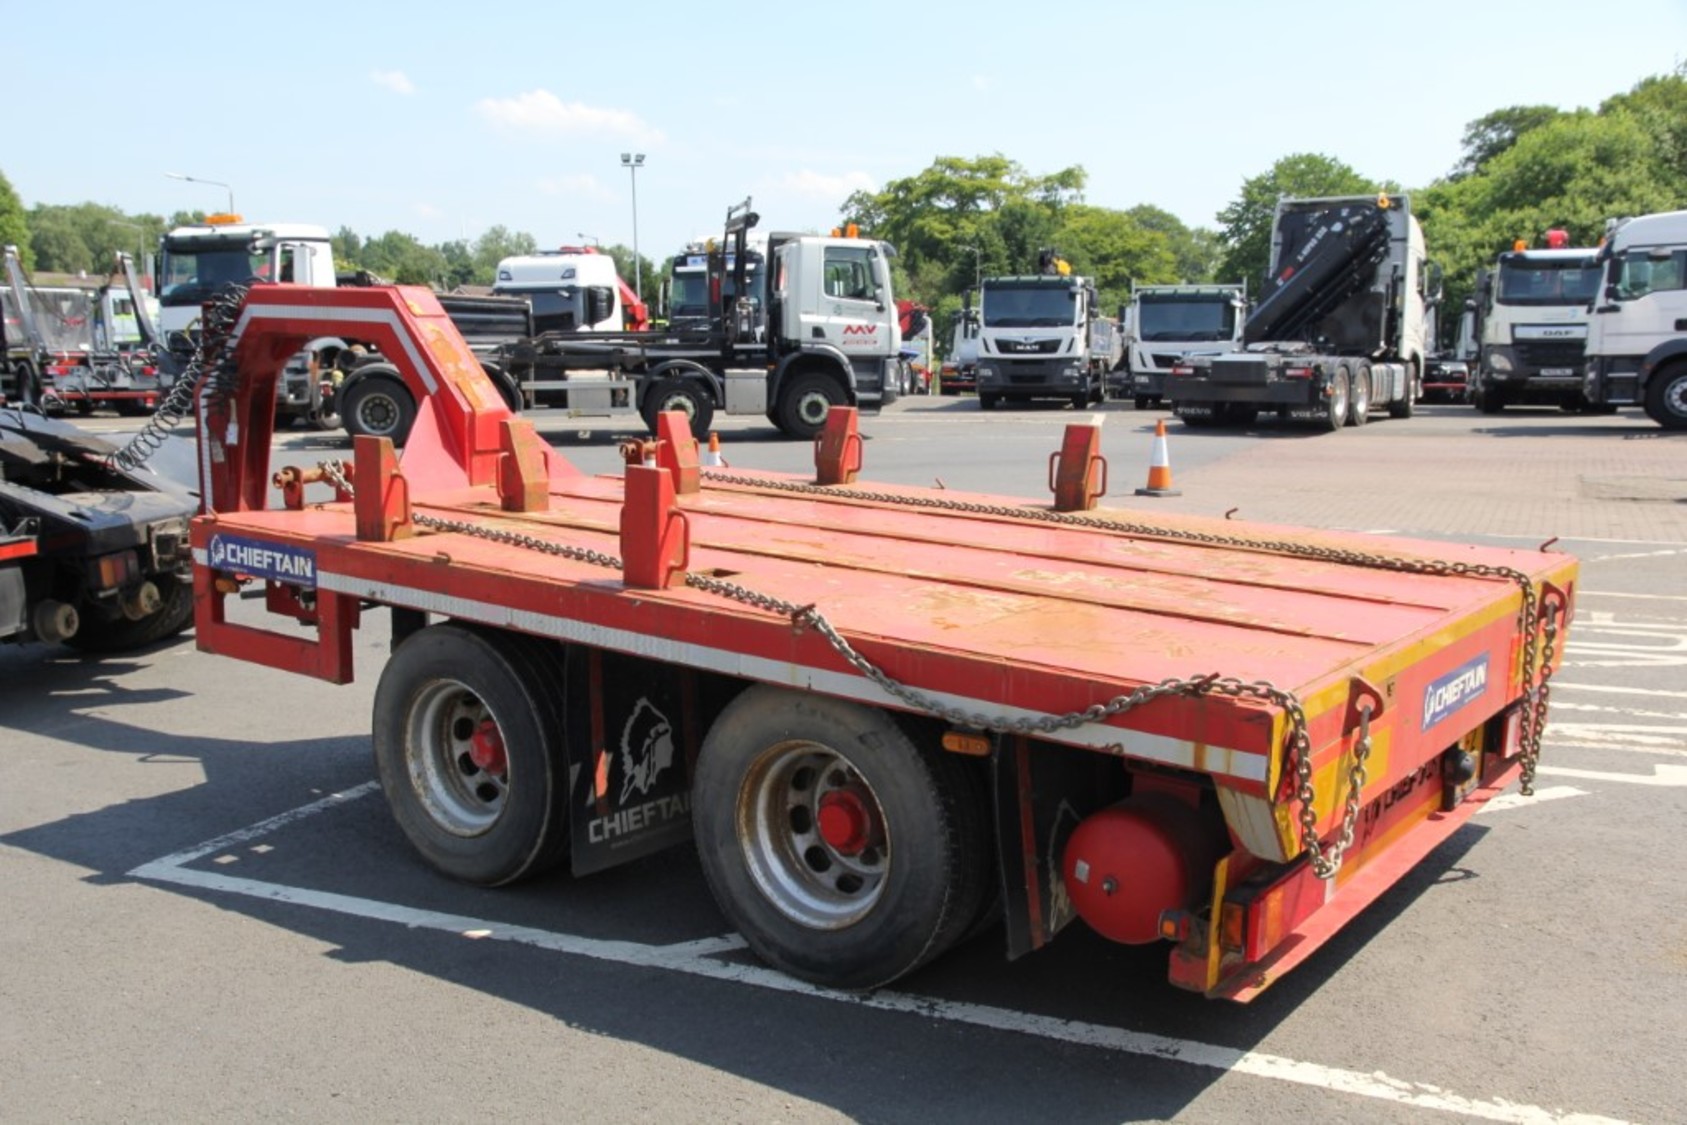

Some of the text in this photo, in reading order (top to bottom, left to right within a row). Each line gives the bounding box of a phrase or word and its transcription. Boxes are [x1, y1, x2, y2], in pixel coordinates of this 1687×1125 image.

[1177, 406, 1212, 415] VOLVO
[226, 542, 313, 578] CHIEFTAIN
[1434, 662, 1487, 713] CHIEFTAIN
[589, 793, 692, 844] CHIEFTAI
